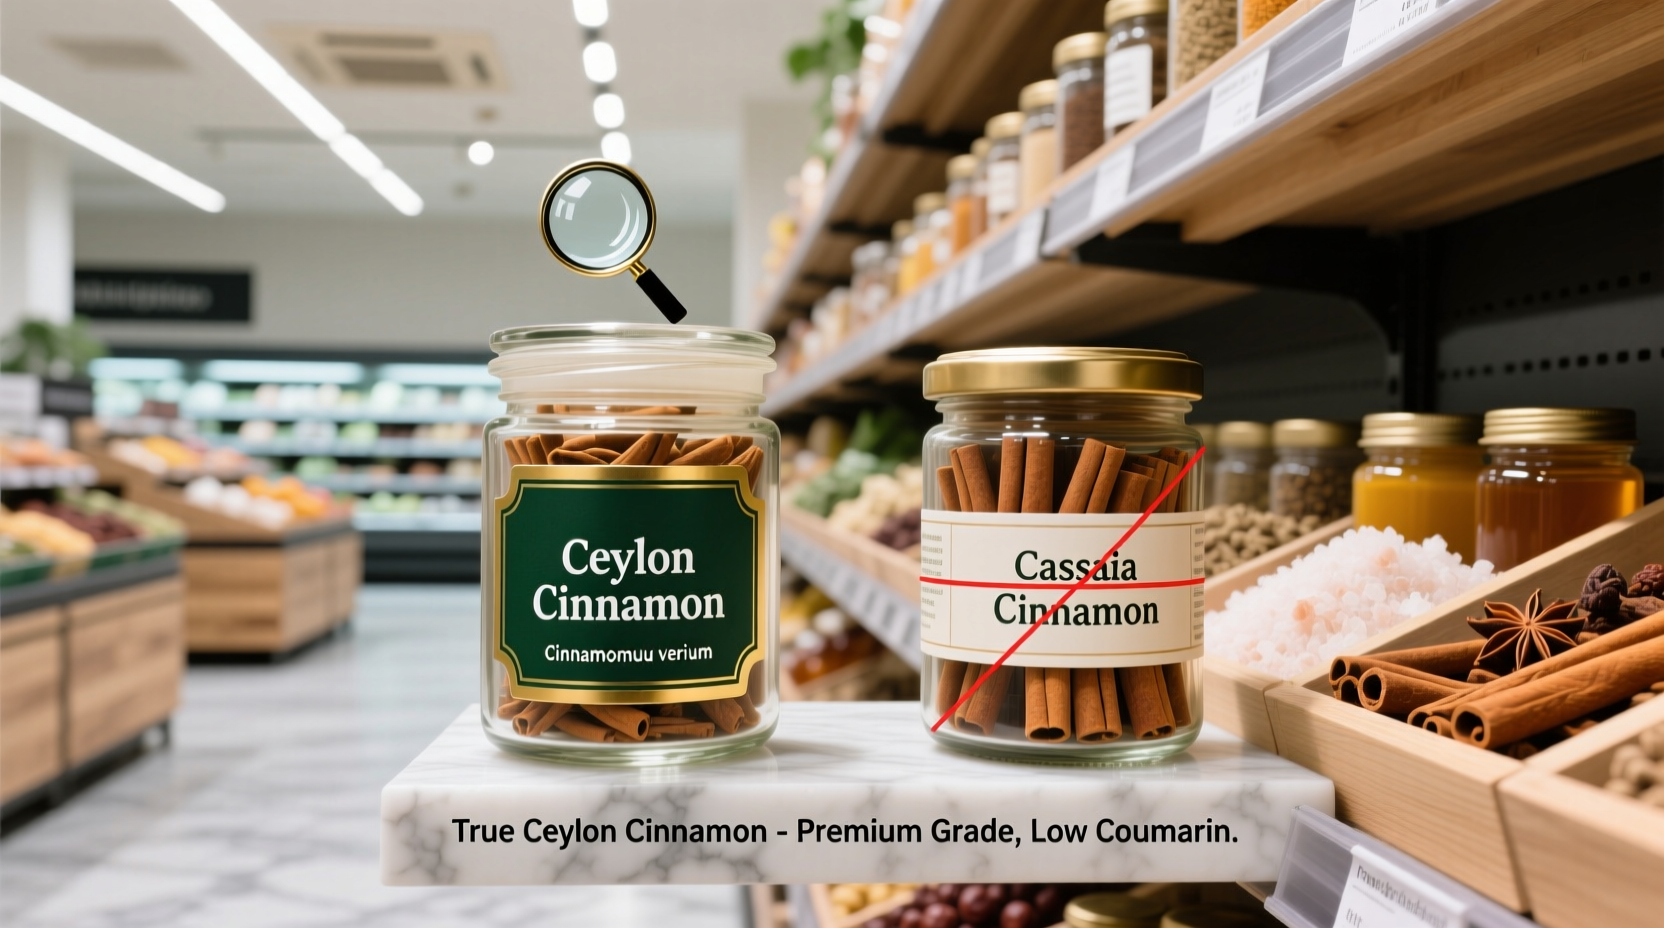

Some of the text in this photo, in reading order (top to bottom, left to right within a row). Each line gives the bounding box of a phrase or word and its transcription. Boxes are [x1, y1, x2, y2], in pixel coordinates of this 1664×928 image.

[562, 536, 695, 585] Ceylon
[1015, 550, 1137, 581] Cassaia
[533, 584, 725, 621] Cinnamon
[994, 592, 1159, 626] Cinnamon
[545, 644, 712, 662] Cinnamomuu verium
